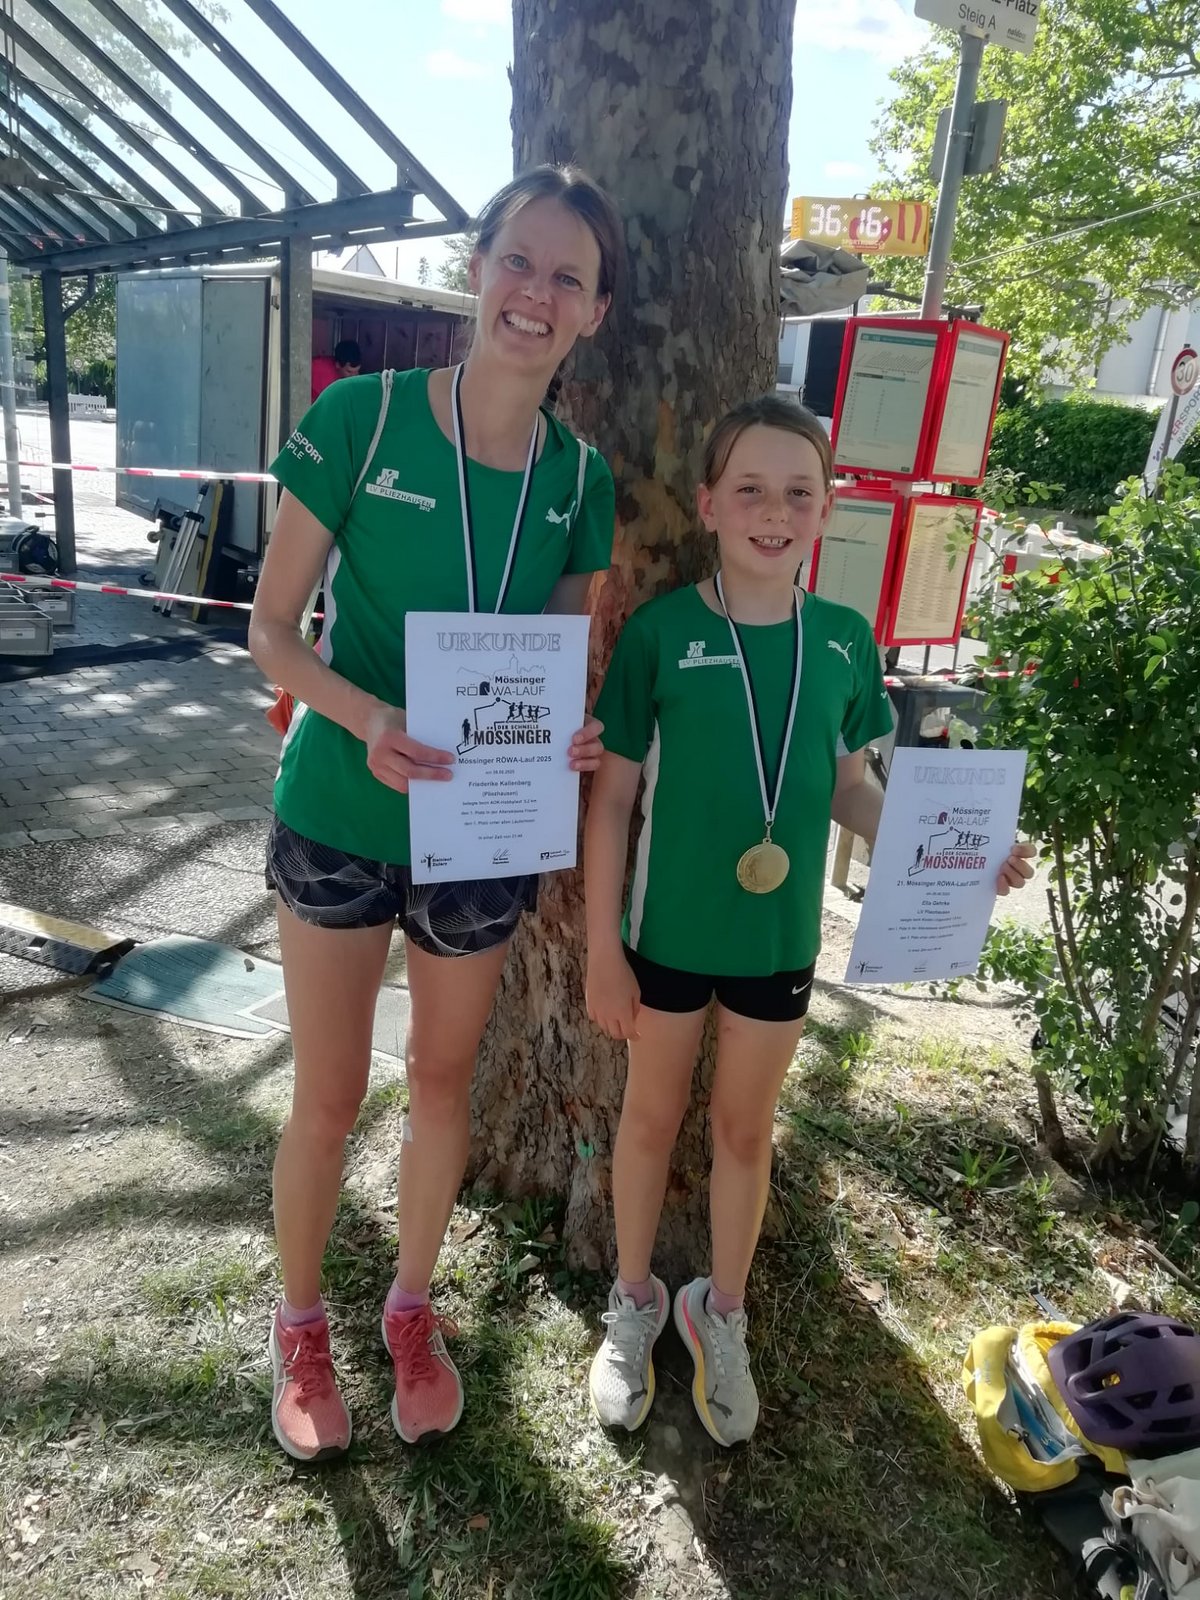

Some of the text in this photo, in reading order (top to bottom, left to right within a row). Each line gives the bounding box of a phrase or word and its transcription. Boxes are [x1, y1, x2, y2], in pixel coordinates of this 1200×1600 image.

[958, 3, 996, 30] Steig A
[1176, 361, 1194, 382] 30
[380, 488, 432, 508] PLIEZHAUSEN
[436, 632, 562, 652] URKUNDE
[495, 676, 546, 684] Mössinger
[474, 727, 551, 745] MÖSSINGER
[458, 757, 494, 765] Mössinger
[914, 766, 1006, 785] URKUNDE
[952, 807, 991, 816] Mössinger
